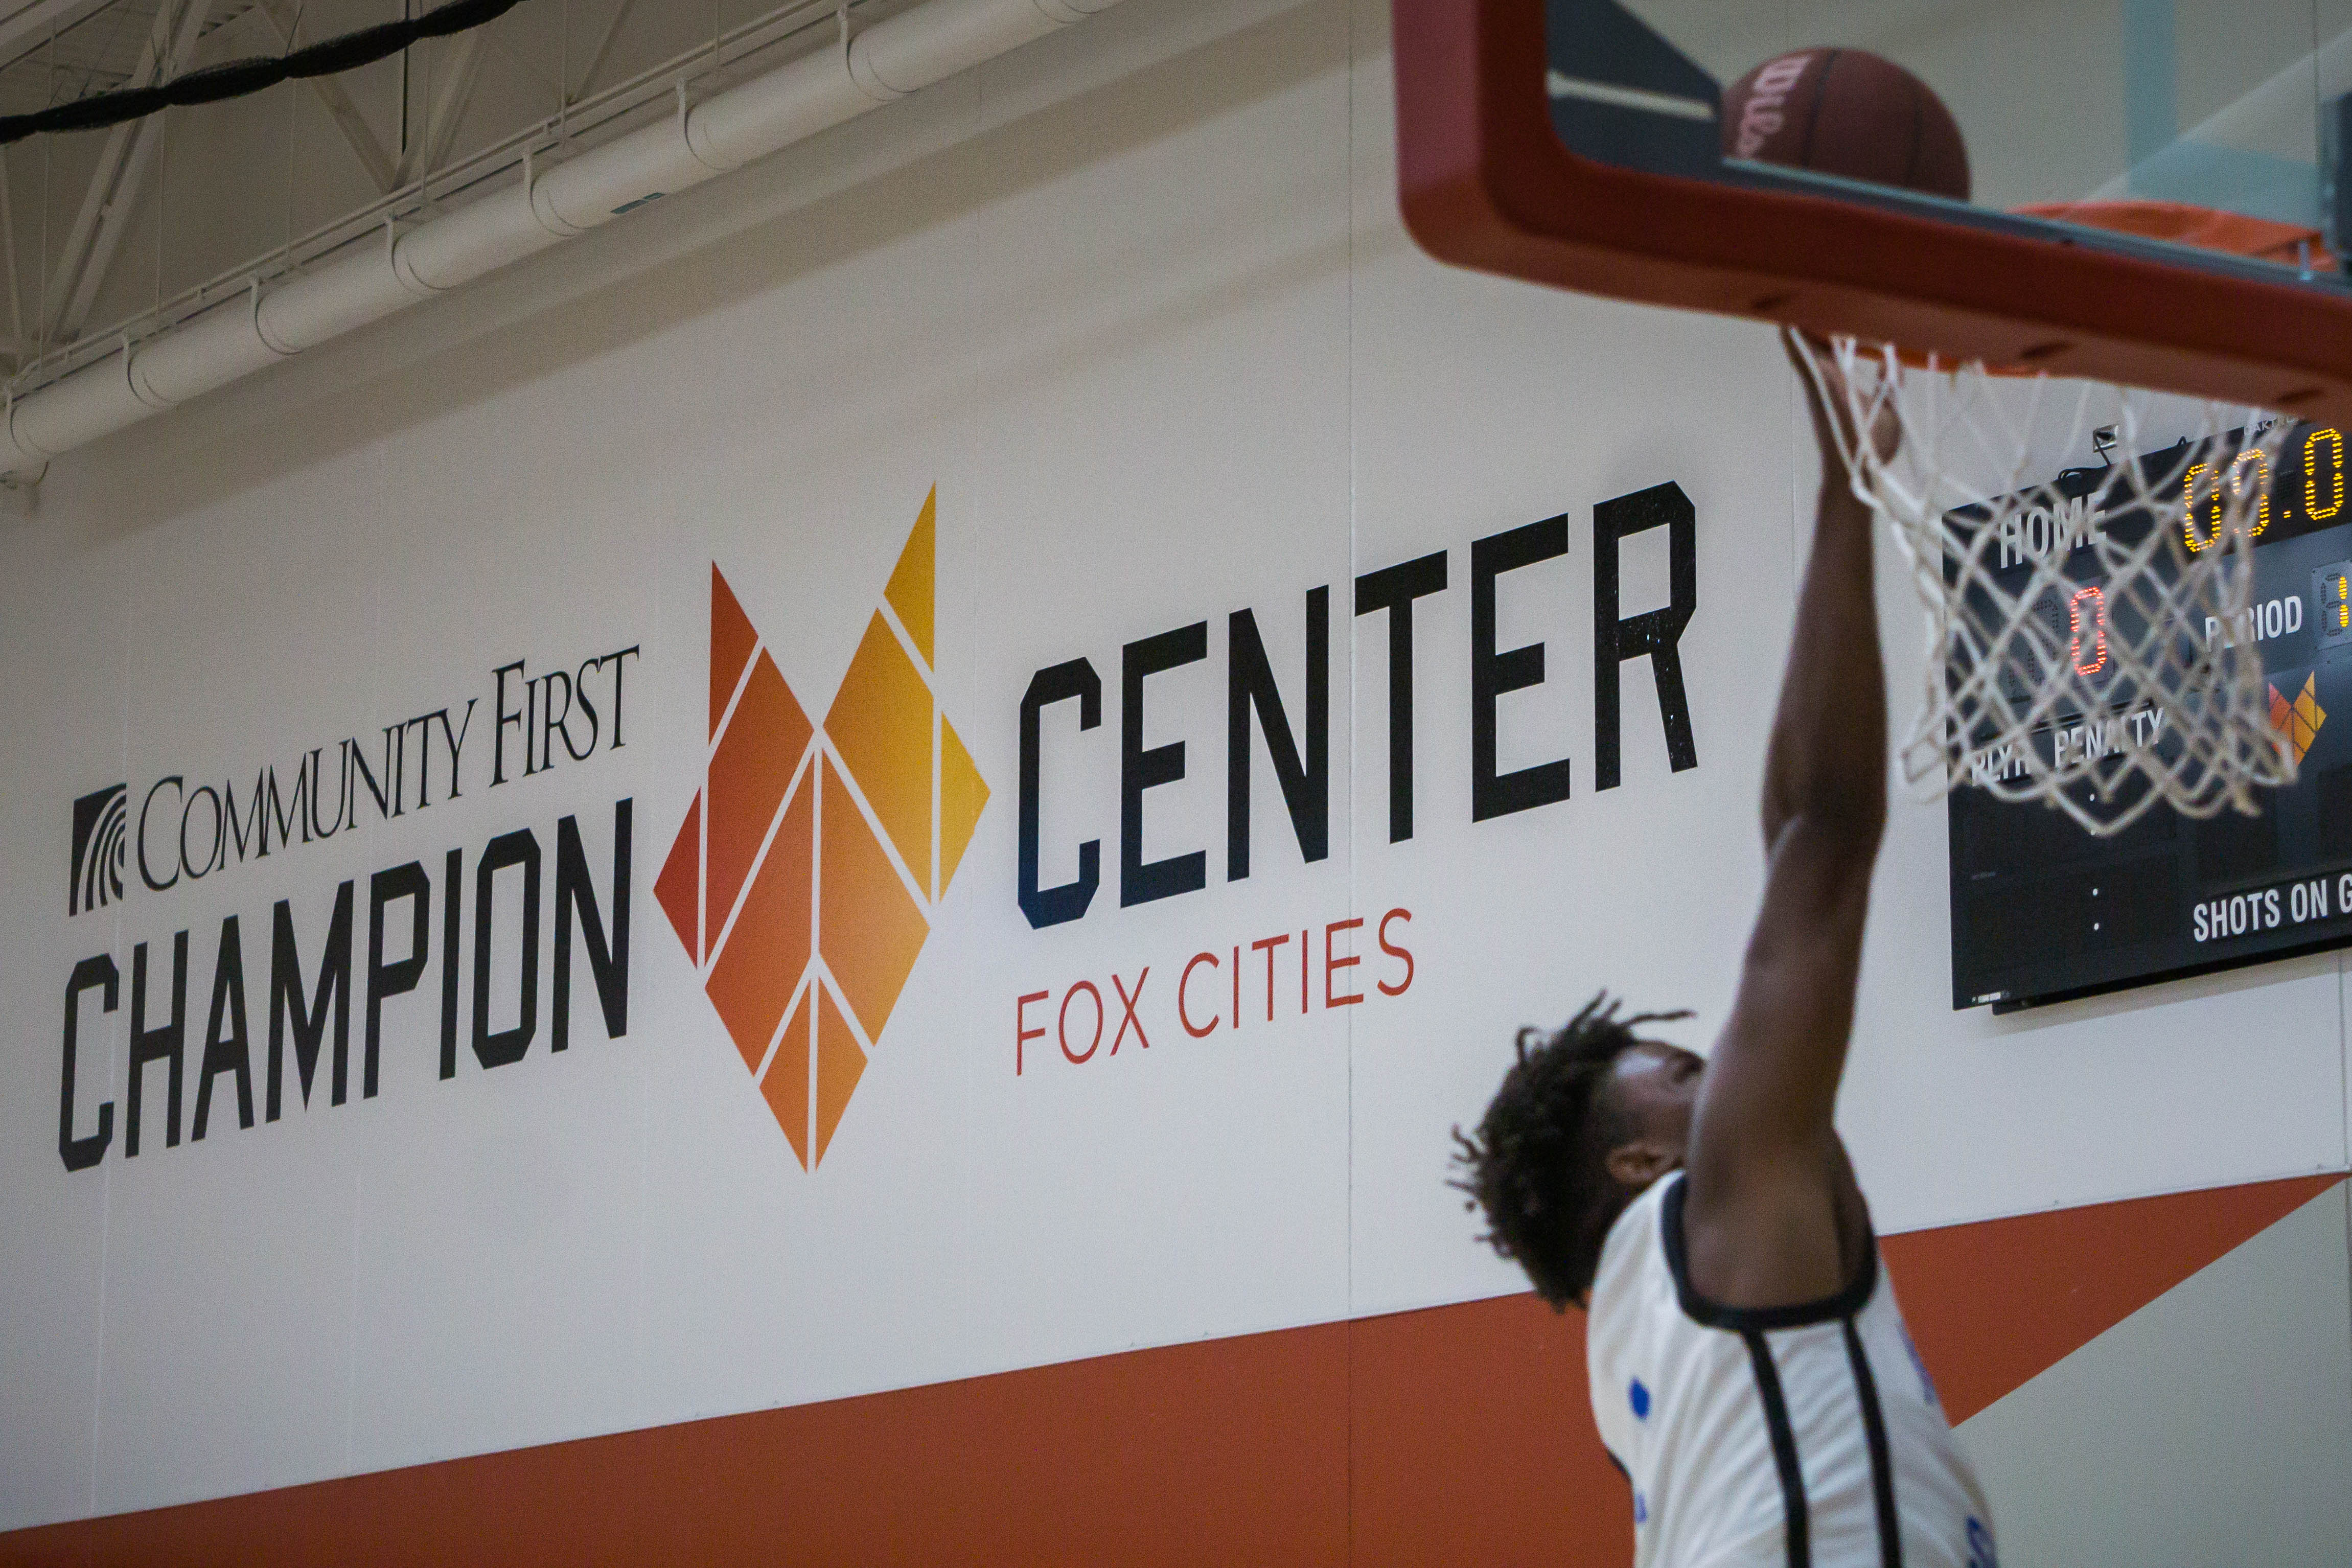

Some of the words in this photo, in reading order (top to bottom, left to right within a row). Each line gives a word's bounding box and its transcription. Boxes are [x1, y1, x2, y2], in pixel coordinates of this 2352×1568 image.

[1999, 492, 2108, 569] HOME
[2070, 585, 2107, 677] 0
[2205, 595, 2302, 653] PIOD
[1017, 480, 1698, 931] CENTER
[2054, 707, 2164, 768] PENATY
[137, 698, 478, 892] COMMUNITY
[489, 643, 640, 788] FIRST
[2194, 888, 2280, 942] SHOTS
[2291, 879, 2328, 923] ON
[58, 796, 633, 1172] CHAMPION
[1017, 966, 1150, 1077] FOX
[1178, 908, 1415, 1039] CITIES
